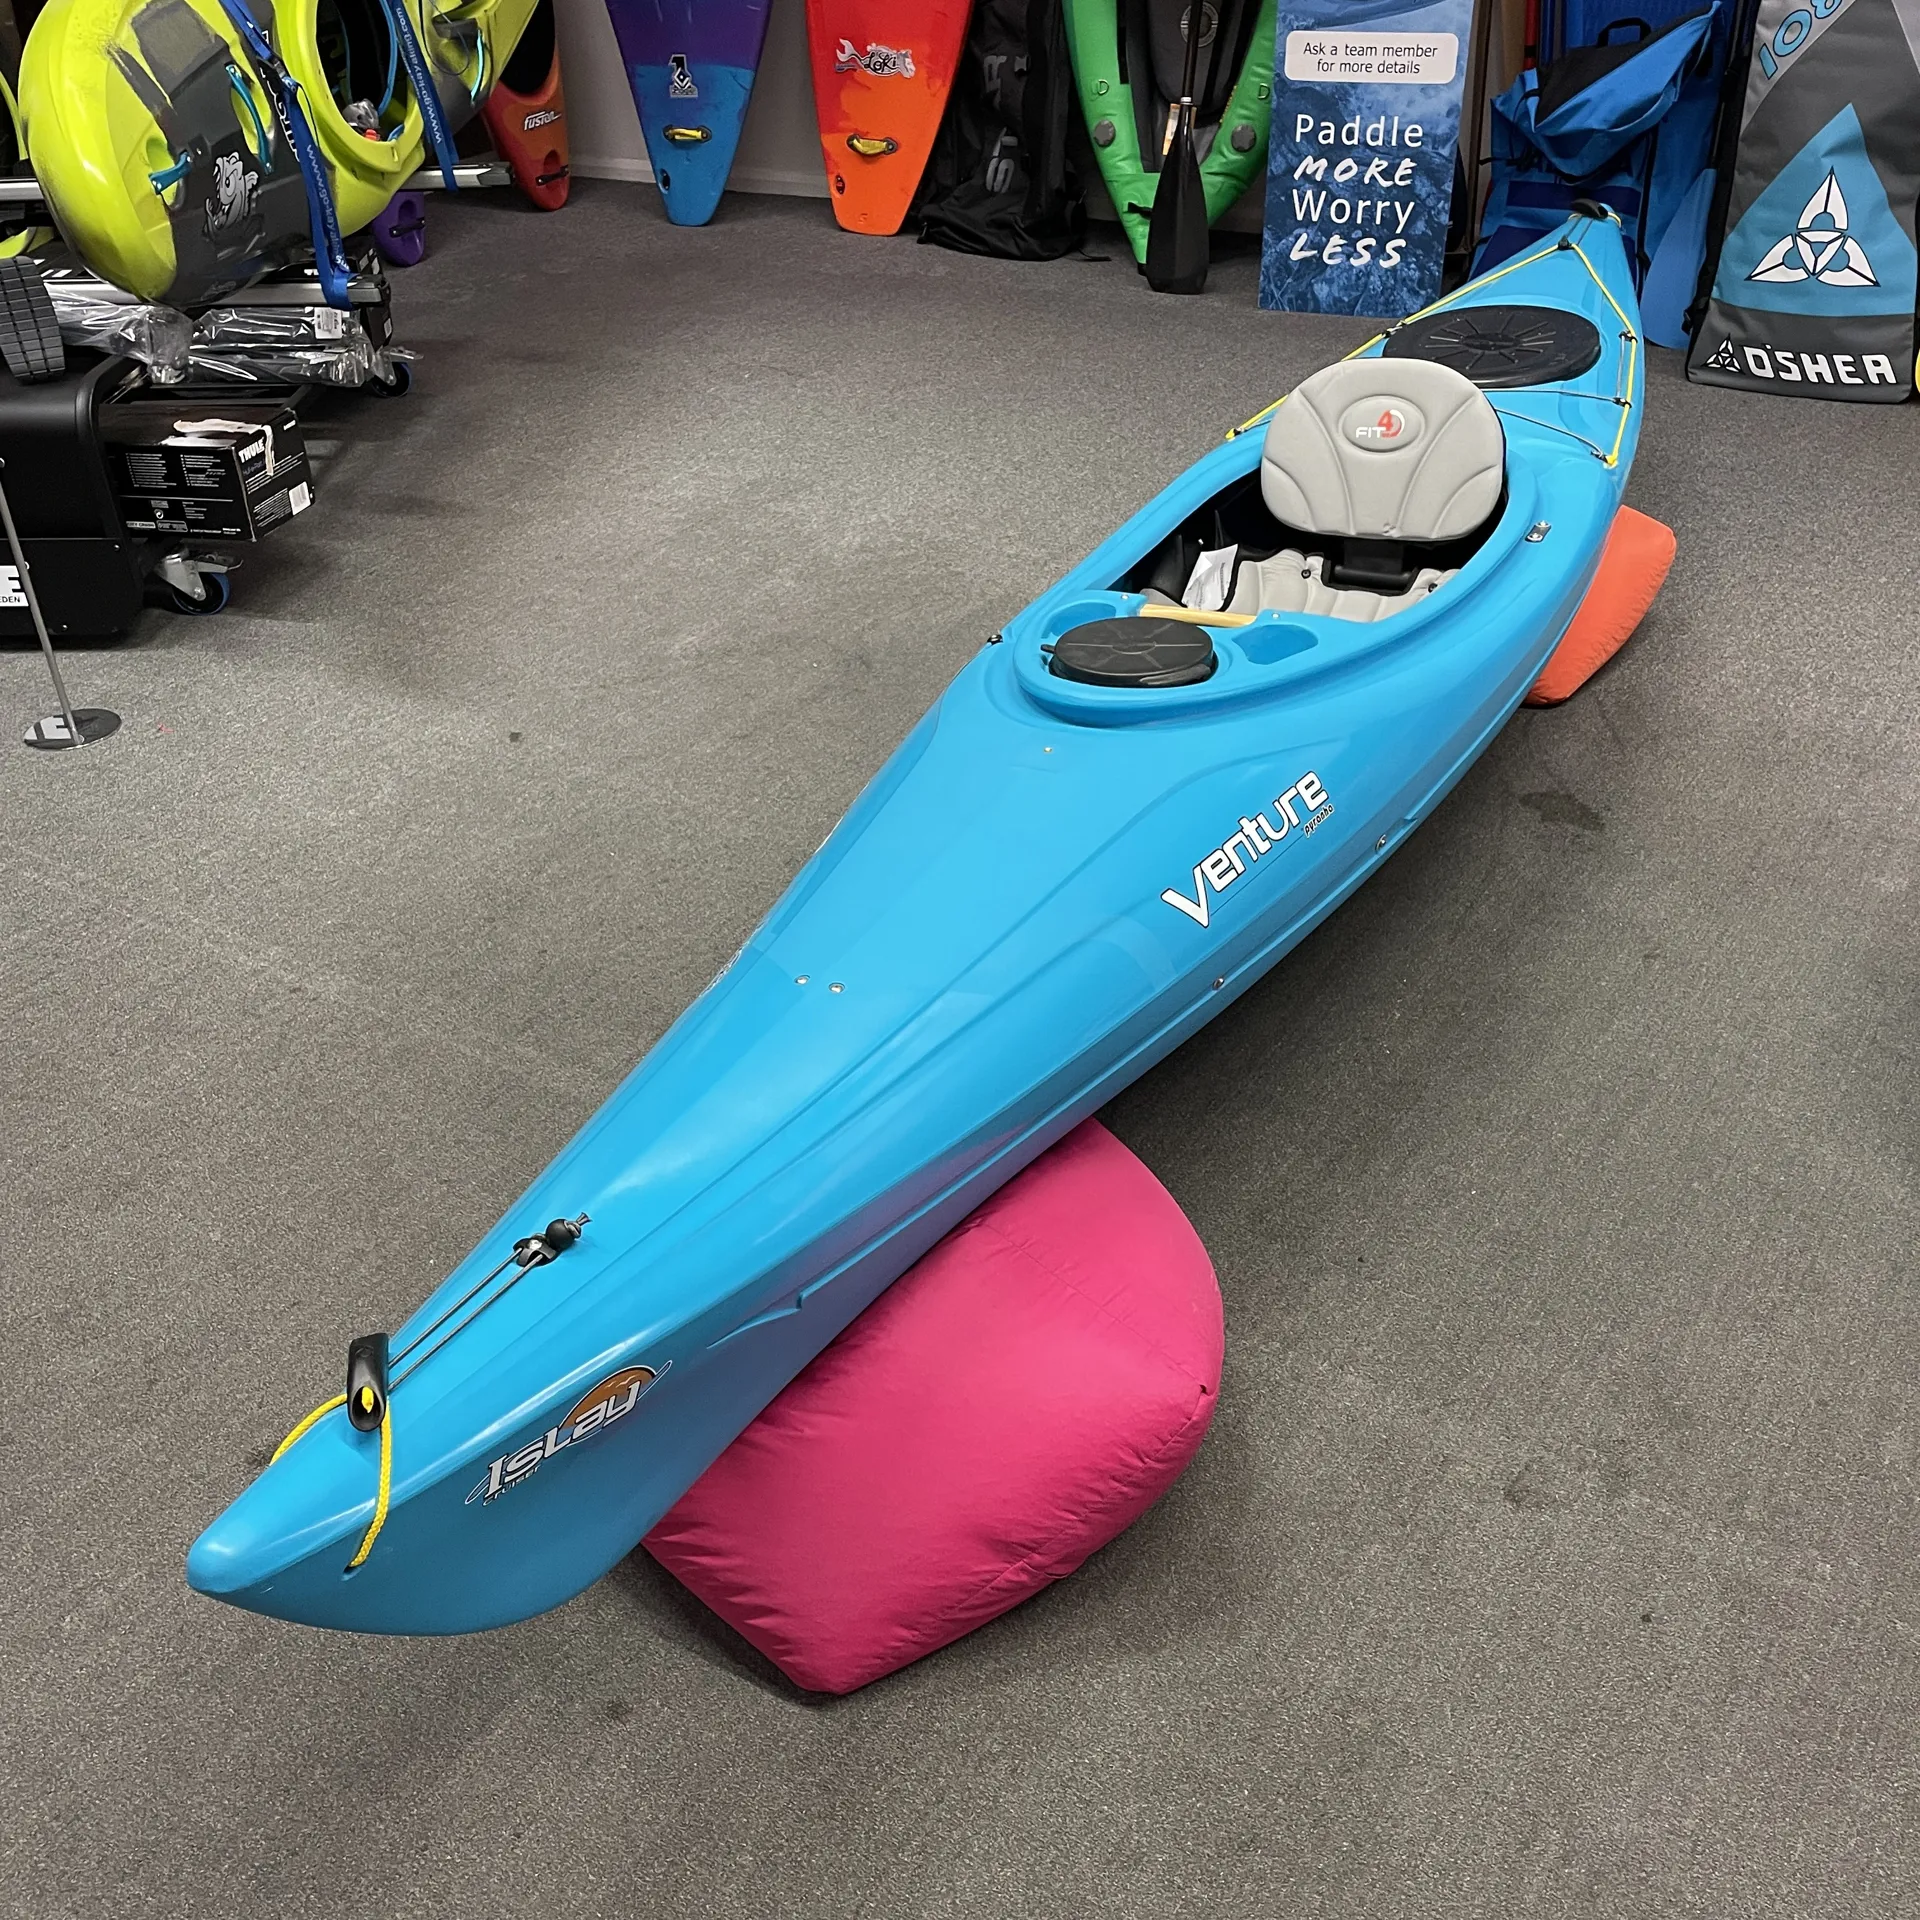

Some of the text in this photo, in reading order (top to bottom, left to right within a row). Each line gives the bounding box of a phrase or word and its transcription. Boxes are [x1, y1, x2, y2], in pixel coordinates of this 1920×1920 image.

[1303, 42, 1438, 58] Ask a team member
[1317, 59, 1420, 74] for more details
[1295, 113, 1424, 148] Paddle
[1293, 155, 1418, 188] MORE
[1292, 188, 1415, 234] Worry
[1289, 232, 1407, 269] LESS
[238, 437, 265, 464] THULE
[1160, 770, 1330, 929] Venture
